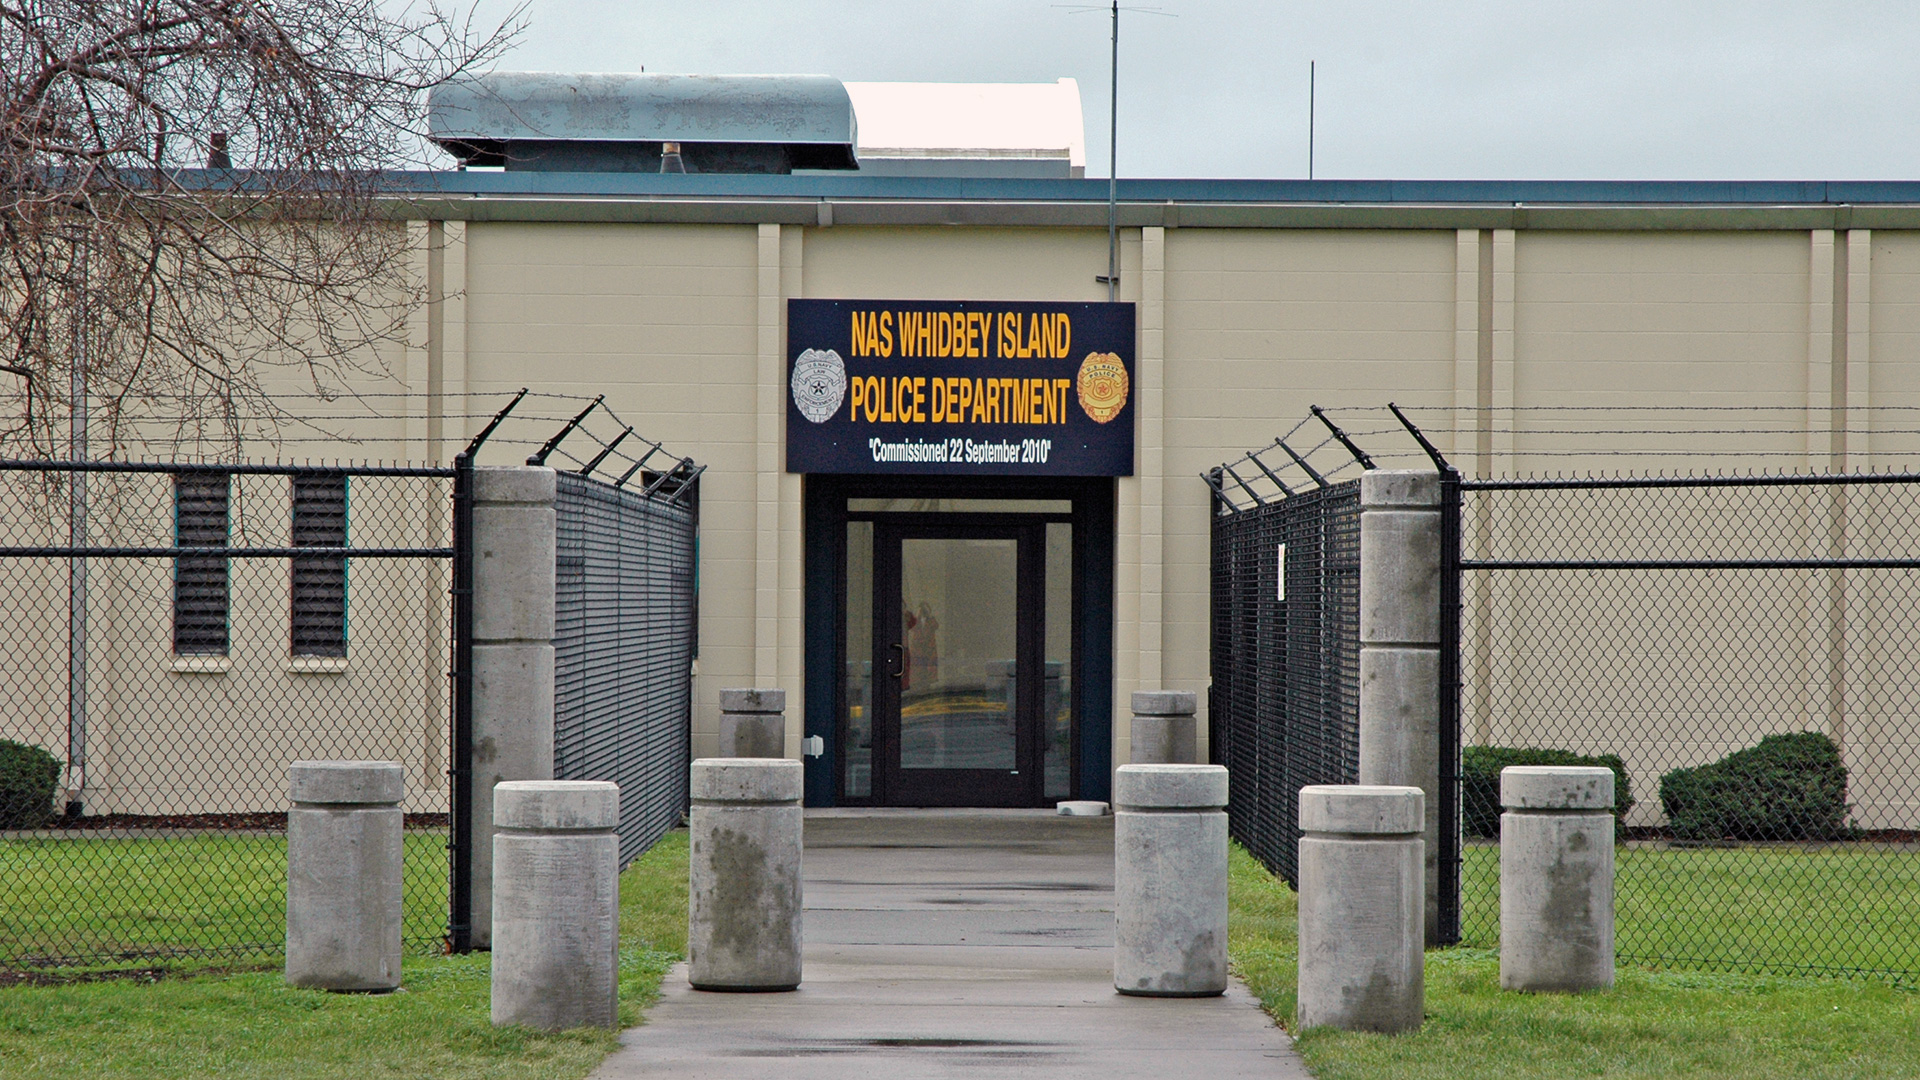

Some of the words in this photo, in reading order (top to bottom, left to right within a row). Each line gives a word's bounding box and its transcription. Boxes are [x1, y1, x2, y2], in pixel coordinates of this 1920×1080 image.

[851, 310, 893, 358] NAS
[898, 311, 993, 358] WHIDBEY
[997, 311, 1071, 359] ISLAND
[1101, 364, 1119, 372] NAVY
[850, 375, 926, 424] POLICE
[931, 377, 1071, 425] DEPARTMENT
[869, 437, 948, 462] "Commissioned
[949, 438, 964, 463] 22
[965, 438, 1021, 465] September
[1021, 438, 1052, 464] 2010"
